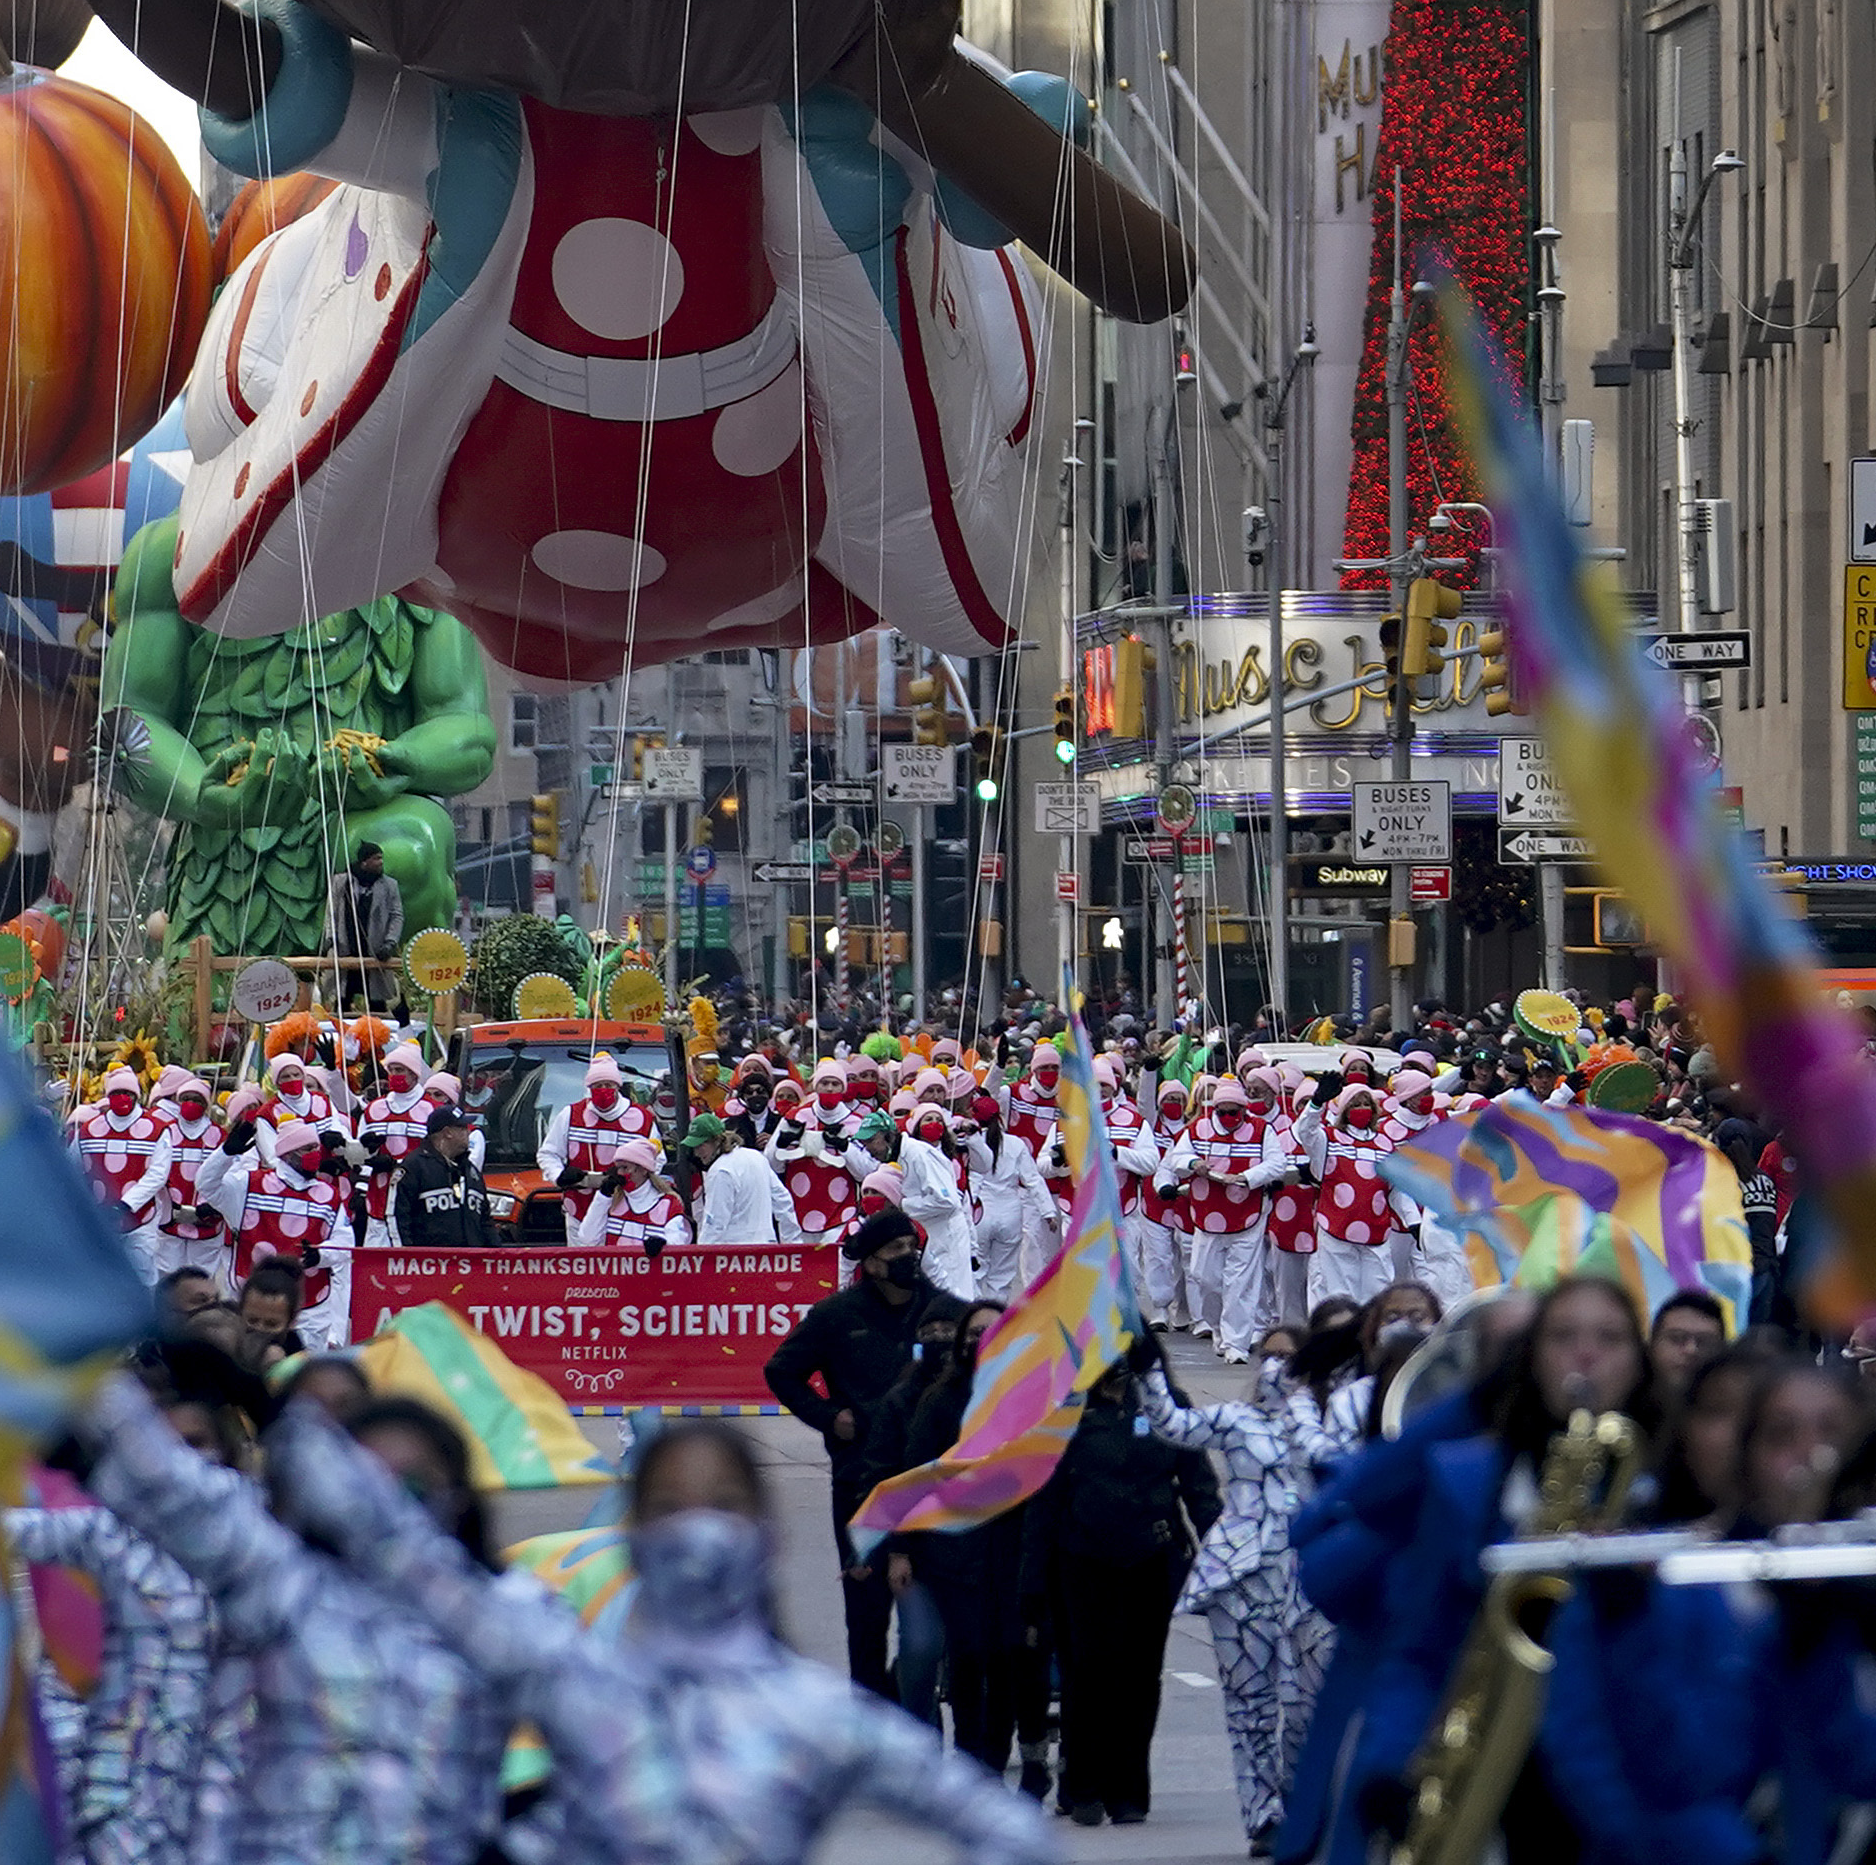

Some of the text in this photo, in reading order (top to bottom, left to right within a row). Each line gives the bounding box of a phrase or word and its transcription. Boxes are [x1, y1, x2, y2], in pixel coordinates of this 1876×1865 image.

[1654, 643, 1736, 659] ONE WAY
[1174, 637, 1323, 725] Musc
[895, 748, 944, 761] BUSES
[900, 765, 938, 778] ONLY
[1526, 773, 1562, 790] ONL
[1372, 788, 1431, 803] BUSES
[1379, 815, 1425, 831] ONLY
[1516, 839, 1588, 853] ONE WAY
[1318, 867, 1388, 886] Subway
[429, 967, 462, 981] 1924
[256, 992, 292, 1013] 1924
[630, 1002, 661, 1023] 1924
[387, 1253, 803, 1276] MACY'S THANKSGIVING DAY PARADE
[563, 1285, 621, 1302] presents
[467, 1305, 601, 1341] TWIST,
[618, 1303, 817, 1336] SCIENTIST
[561, 1345, 628, 1360] NETFLIX
